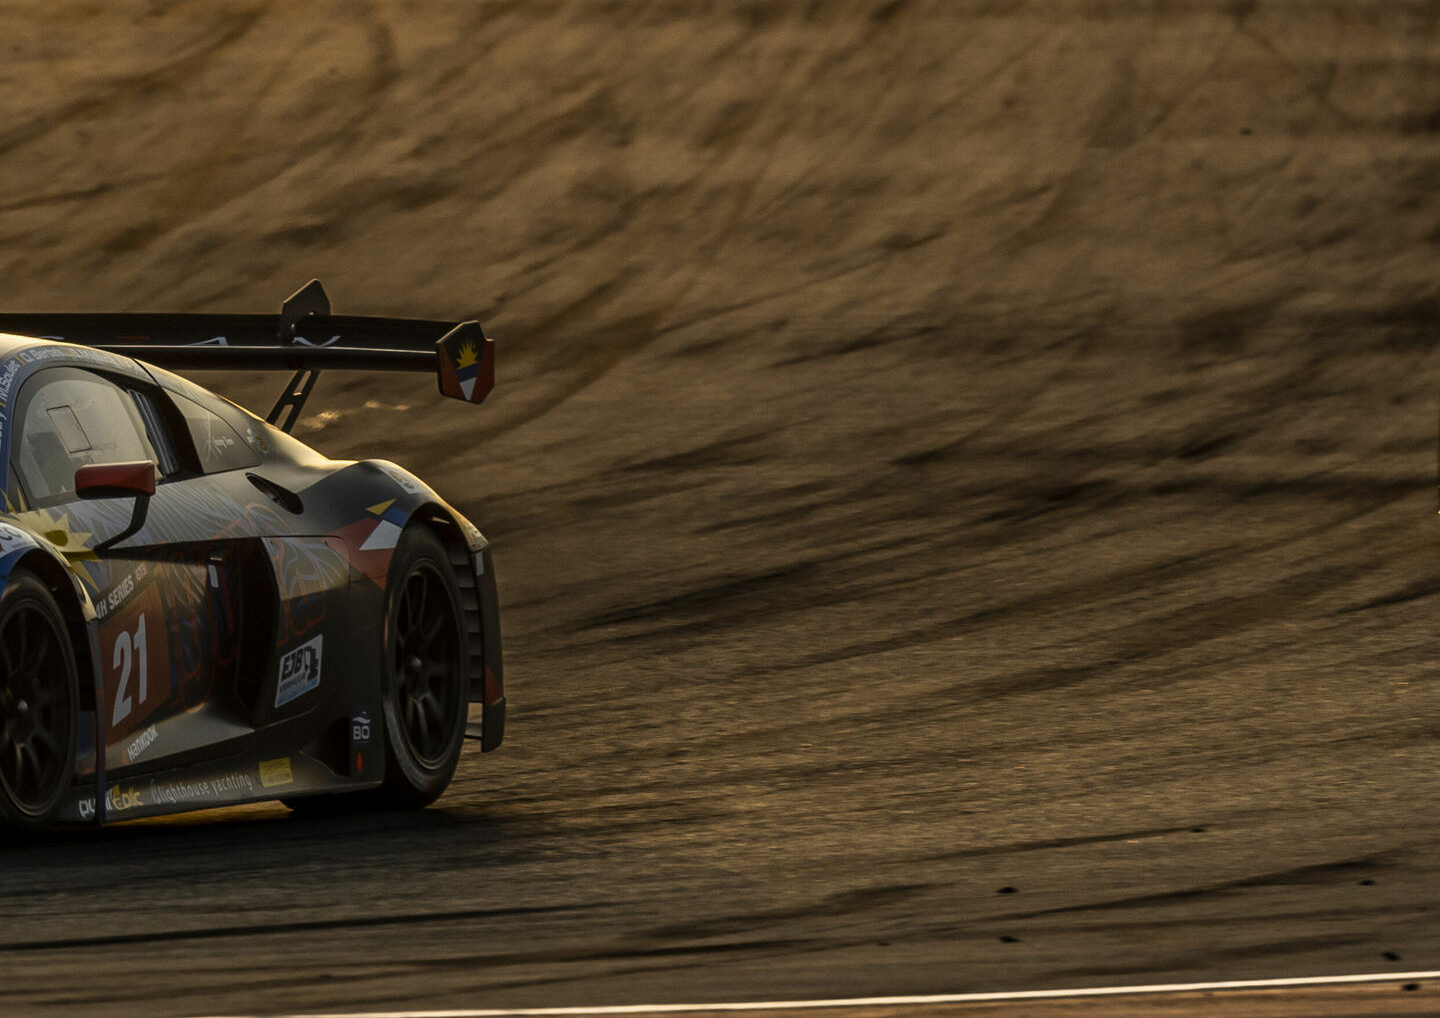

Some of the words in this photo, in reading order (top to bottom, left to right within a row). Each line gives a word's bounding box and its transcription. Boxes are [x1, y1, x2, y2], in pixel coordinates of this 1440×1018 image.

[108, 574, 135, 610] SERIES
[111, 612, 147, 728] 21
[210, 772, 253, 797] yachting
